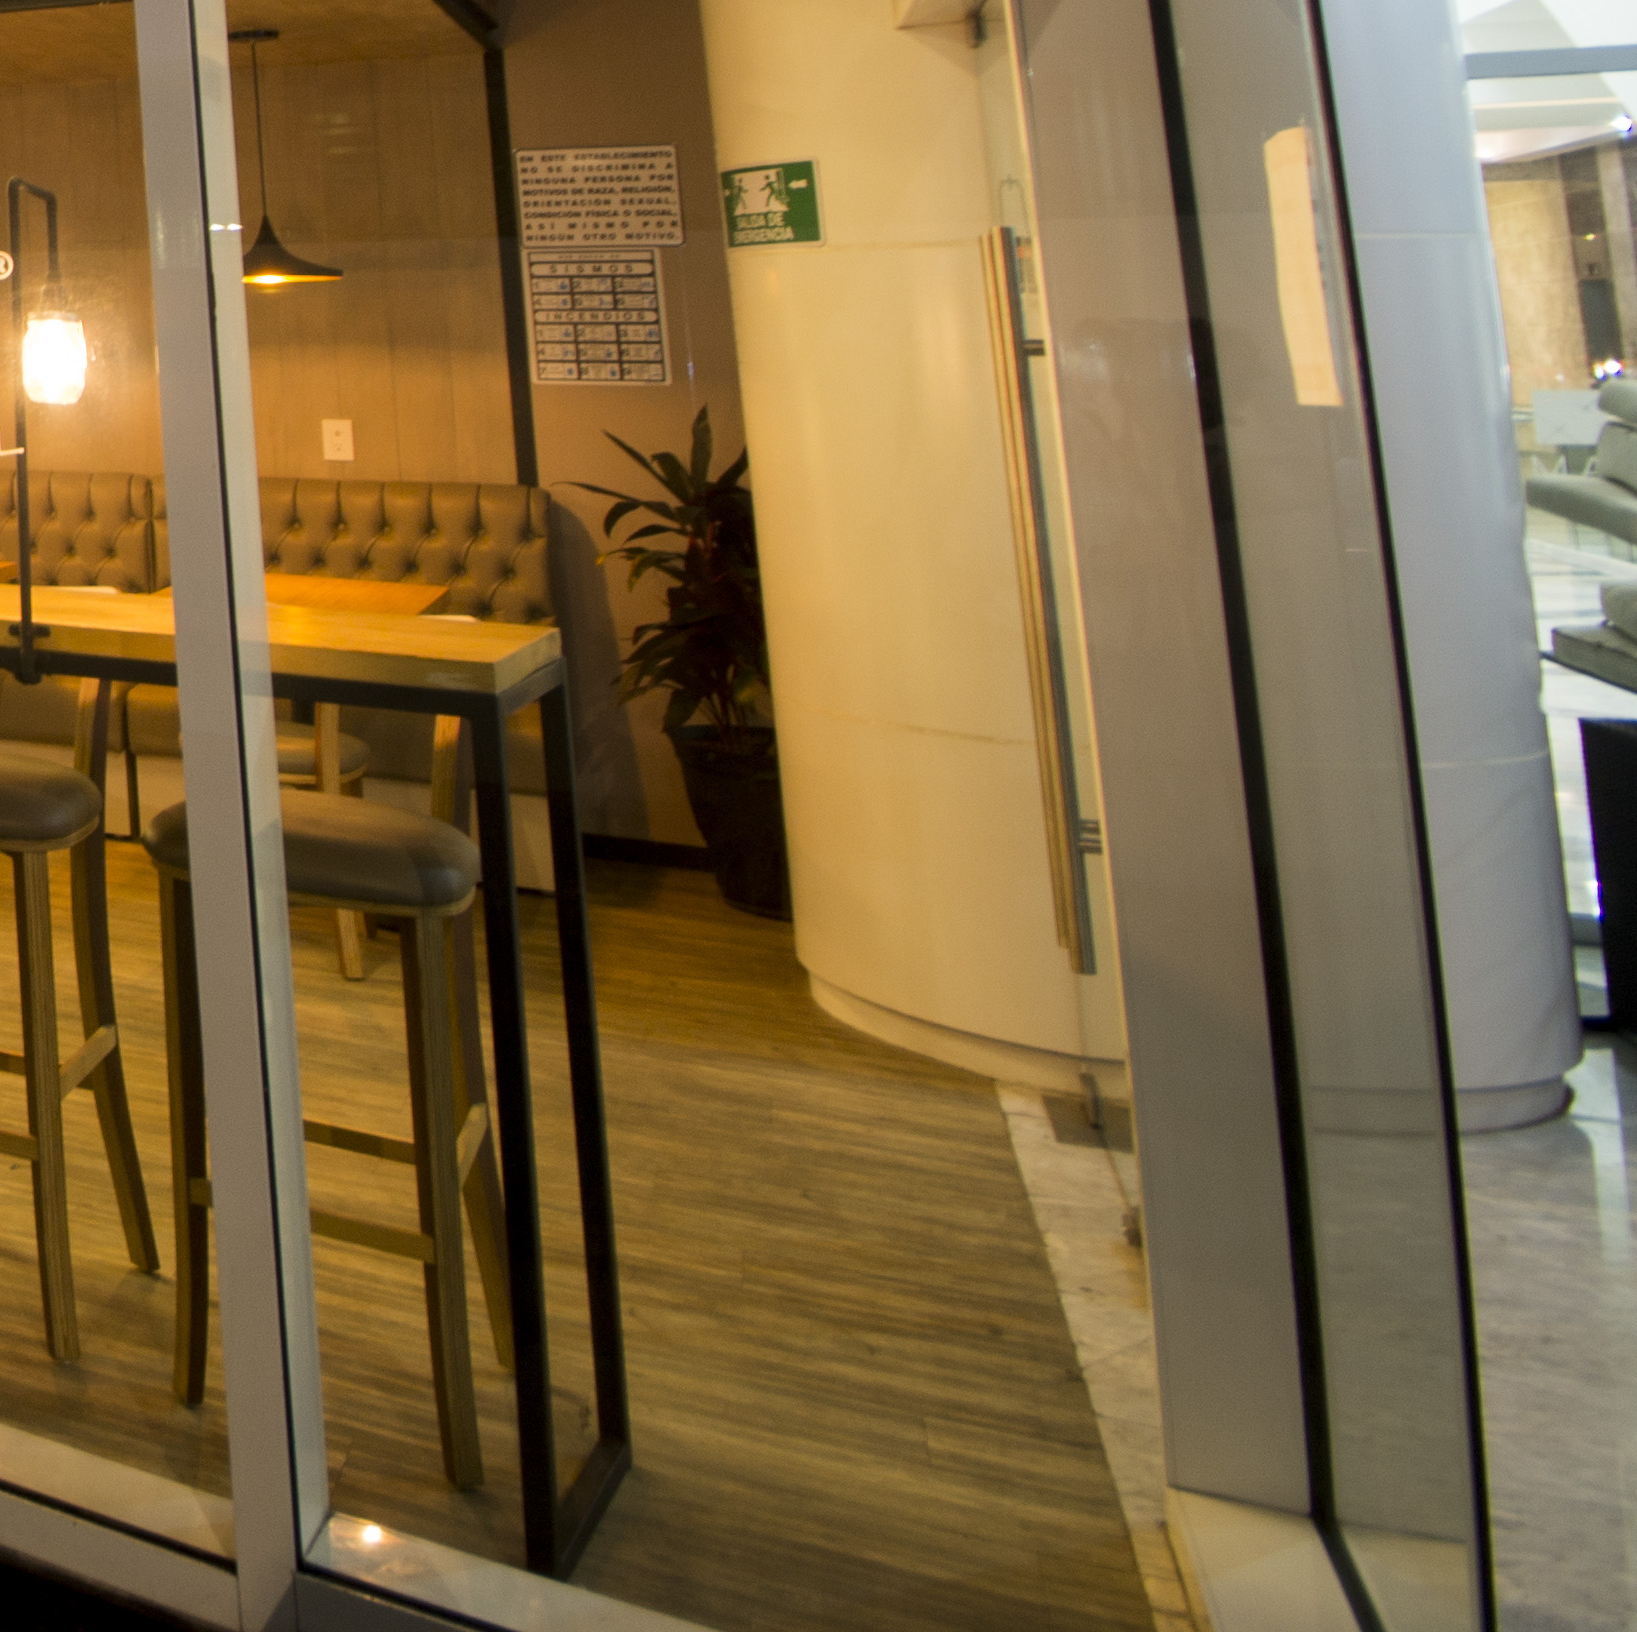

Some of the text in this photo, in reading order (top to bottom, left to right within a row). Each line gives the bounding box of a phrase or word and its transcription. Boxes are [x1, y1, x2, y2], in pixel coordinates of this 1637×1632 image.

[572, 163, 655, 172] DISCRIMINA
[584, 175, 641, 183] PERSONA
[523, 188, 569, 196] MOTIVOS
[767, 213, 784, 227] DE
